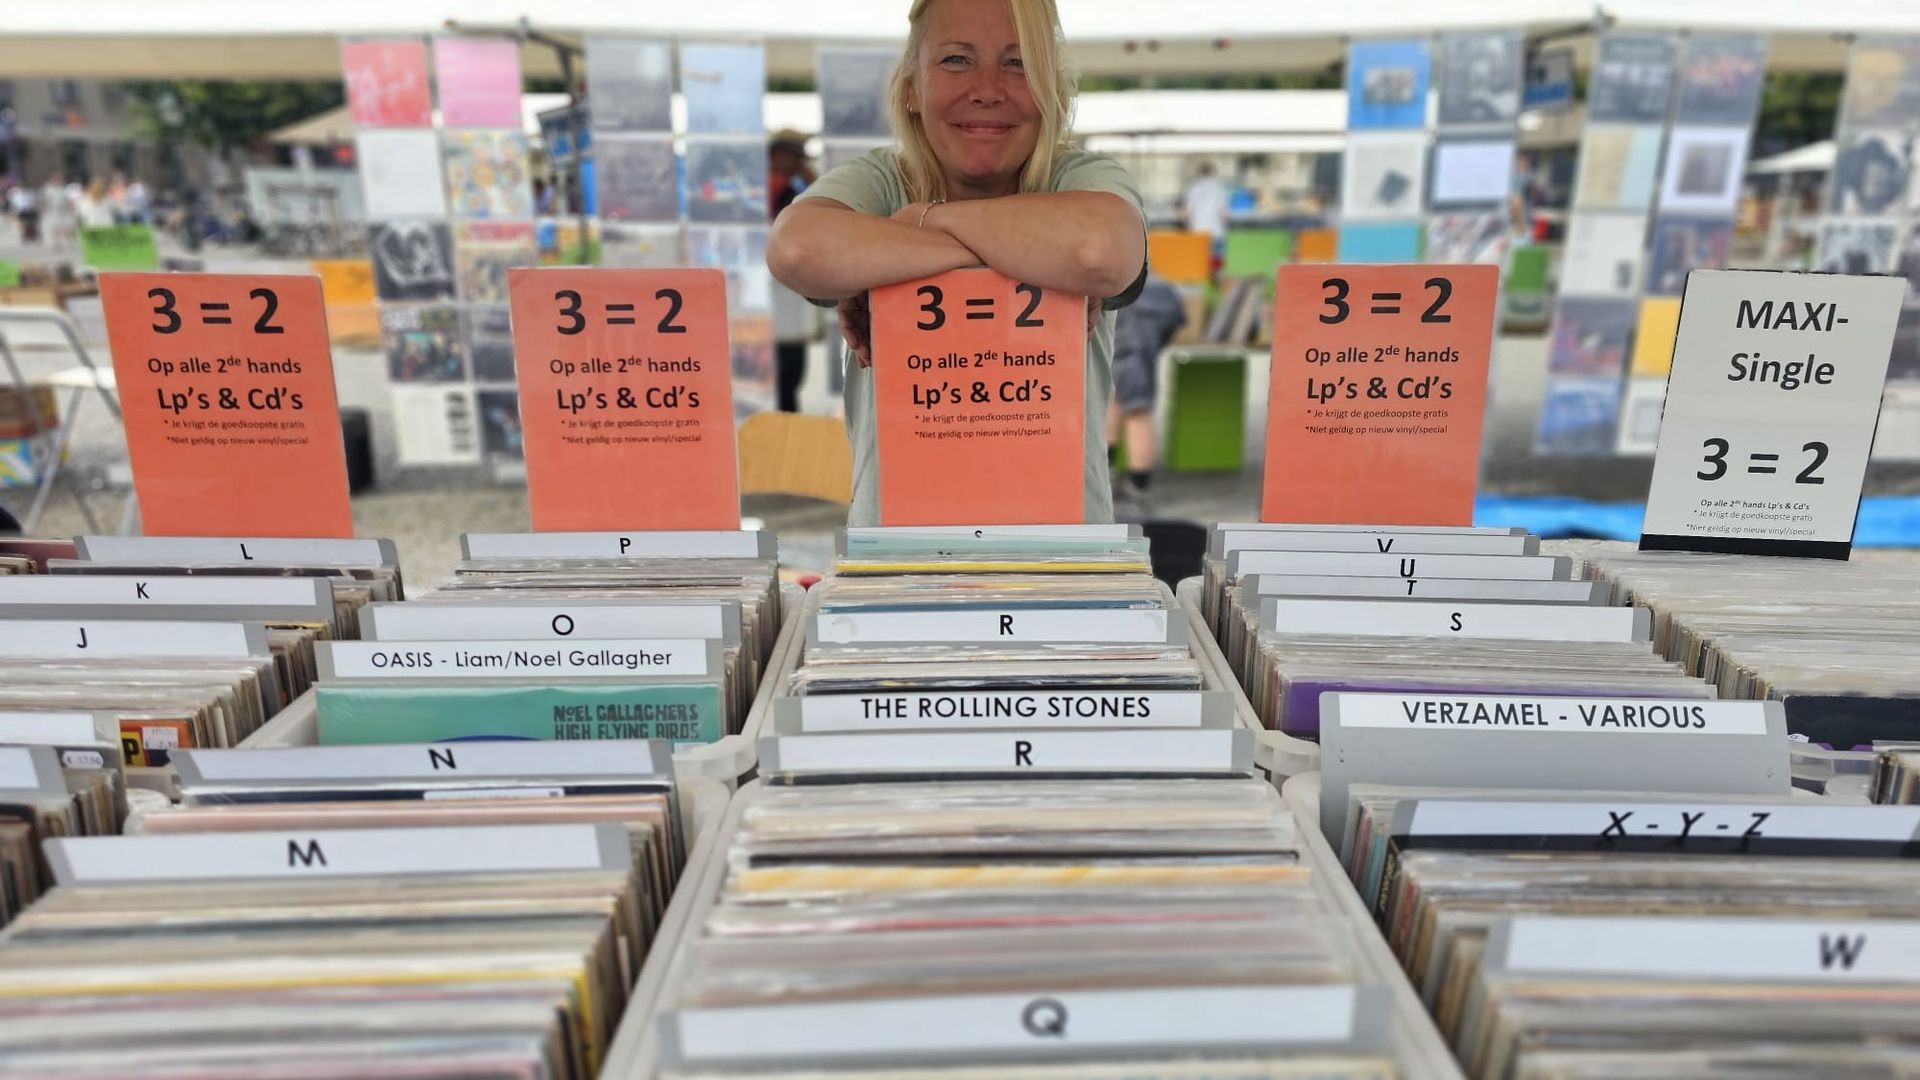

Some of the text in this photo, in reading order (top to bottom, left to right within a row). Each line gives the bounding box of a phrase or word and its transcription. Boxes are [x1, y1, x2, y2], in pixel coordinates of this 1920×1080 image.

[148, 288, 284, 334] 3 = 2
[916, 283, 1044, 330] 3 = 2
[1319, 278, 1452, 324] 3 = 2
[555, 289, 686, 335] 3 = 2
[1736, 300, 1848, 331] MAXI-
[908, 350, 1055, 372] Op alle 2de hands
[1306, 345, 1459, 366] Op alle 2de hands
[148, 356, 301, 376] Op alle 2de hands
[550, 356, 700, 377] Op alle 2de hands
[1728, 353, 1834, 390] Single
[557, 386, 699, 414] Lp's & Cd's
[913, 379, 1051, 409] Lp's & Cd's
[1308, 376, 1451, 404] Lp's & Cd's
[158, 387, 303, 414] Lp's & Cd's
[933, 414, 954, 424] krijgt
[957, 414, 967, 422] de
[970, 413, 1024, 423] goedkoopste
[1027, 412, 1050, 421] gratis
[1326, 410, 1348, 418] krijgt
[1364, 410, 1421, 418] goedkoopste
[1423, 410, 1448, 418] gratis
[183, 420, 205, 430] krijgt
[208, 420, 218, 428] de
[222, 420, 278, 429] goedkoopste
[281, 421, 305, 429] gratis
[579, 421, 601, 429] krijgt
[618, 420, 673, 429] goedkoopste
[675, 420, 699, 428] gratis
[938, 430, 961, 439] geldig
[1002, 427, 1050, 436] vinyl/special
[1329, 426, 1353, 434] geldig
[1396, 426, 1447, 434] vinyl/special
[191, 436, 215, 445] geldig
[257, 437, 308, 446] vinyl/special
[586, 435, 609, 444] geldig
[652, 435, 701, 443] vinyl/special
[1697, 438, 1828, 484] 3 = 2
[1701, 500, 1712, 508] Op
[1743, 501, 1766, 509] hands
[240, 544, 253, 560] L
[620, 538, 630, 554] P
[1377, 539, 1394, 552] V
[1400, 559, 1415, 577] U
[137, 583, 149, 598] K
[1407, 580, 1417, 595] T
[552, 615, 574, 635] O
[1000, 615, 1013, 635] R
[1450, 613, 1462, 631] S
[77, 628, 87, 648] J
[372, 652, 432, 667] OASIS
[456, 651, 561, 668] Liam/Noel
[569, 650, 671, 669] Gallagher
[861, 697, 1150, 718] THE ROLLING STONES
[1402, 701, 1548, 725] VERZAMEL
[1578, 705, 1705, 728] VARIOUS
[555, 723, 591, 740] HIGH
[598, 723, 648, 739] FLYING
[429, 749, 456, 769] N
[1016, 741, 1032, 766] R
[1601, 811, 1634, 835] X
[1682, 812, 1705, 837] Y
[1745, 813, 1771, 836] Z
[288, 840, 326, 866] M
[1821, 936, 1864, 969] W
[1022, 999, 1067, 1036] Q
